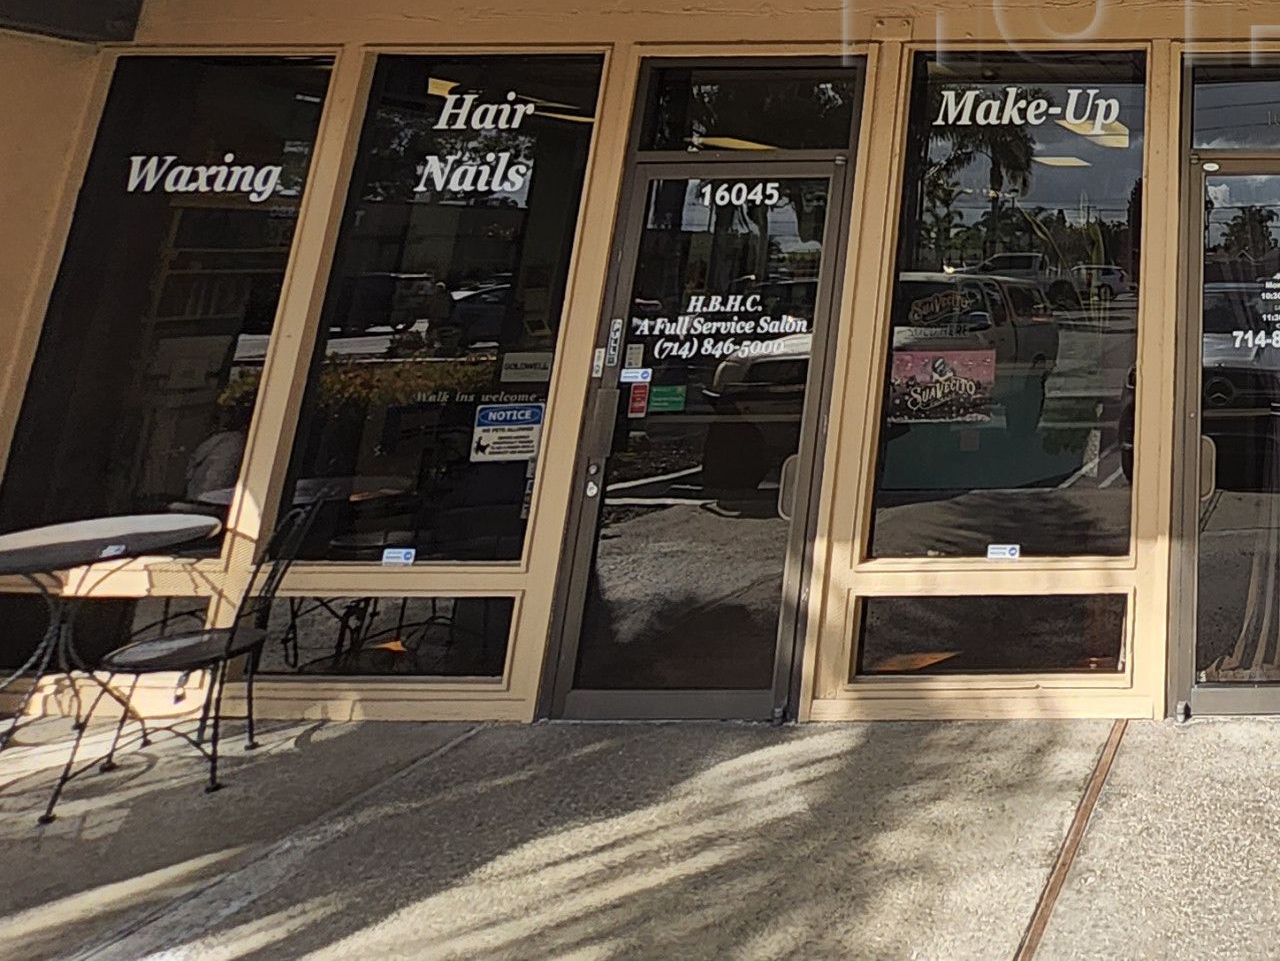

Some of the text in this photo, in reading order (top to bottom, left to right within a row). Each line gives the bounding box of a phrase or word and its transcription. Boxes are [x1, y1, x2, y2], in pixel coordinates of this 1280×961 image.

[432, 91, 535, 130] Hair
[932, 87, 1120, 135] Make-Up
[126, 152, 283, 203] Waxing
[413, 152, 529, 193] Nails
[701, 182, 780, 206] 16045
[686, 295, 763, 313] H.B.H.C.
[635, 314, 808, 335] A Full Service Salon
[653, 338, 699, 359] (714)
[701, 337, 786, 359] 846-5000
[416, 391, 449, 403] Walk
[456, 391, 475, 403] ins
[488, 409, 532, 421] NOTICE
